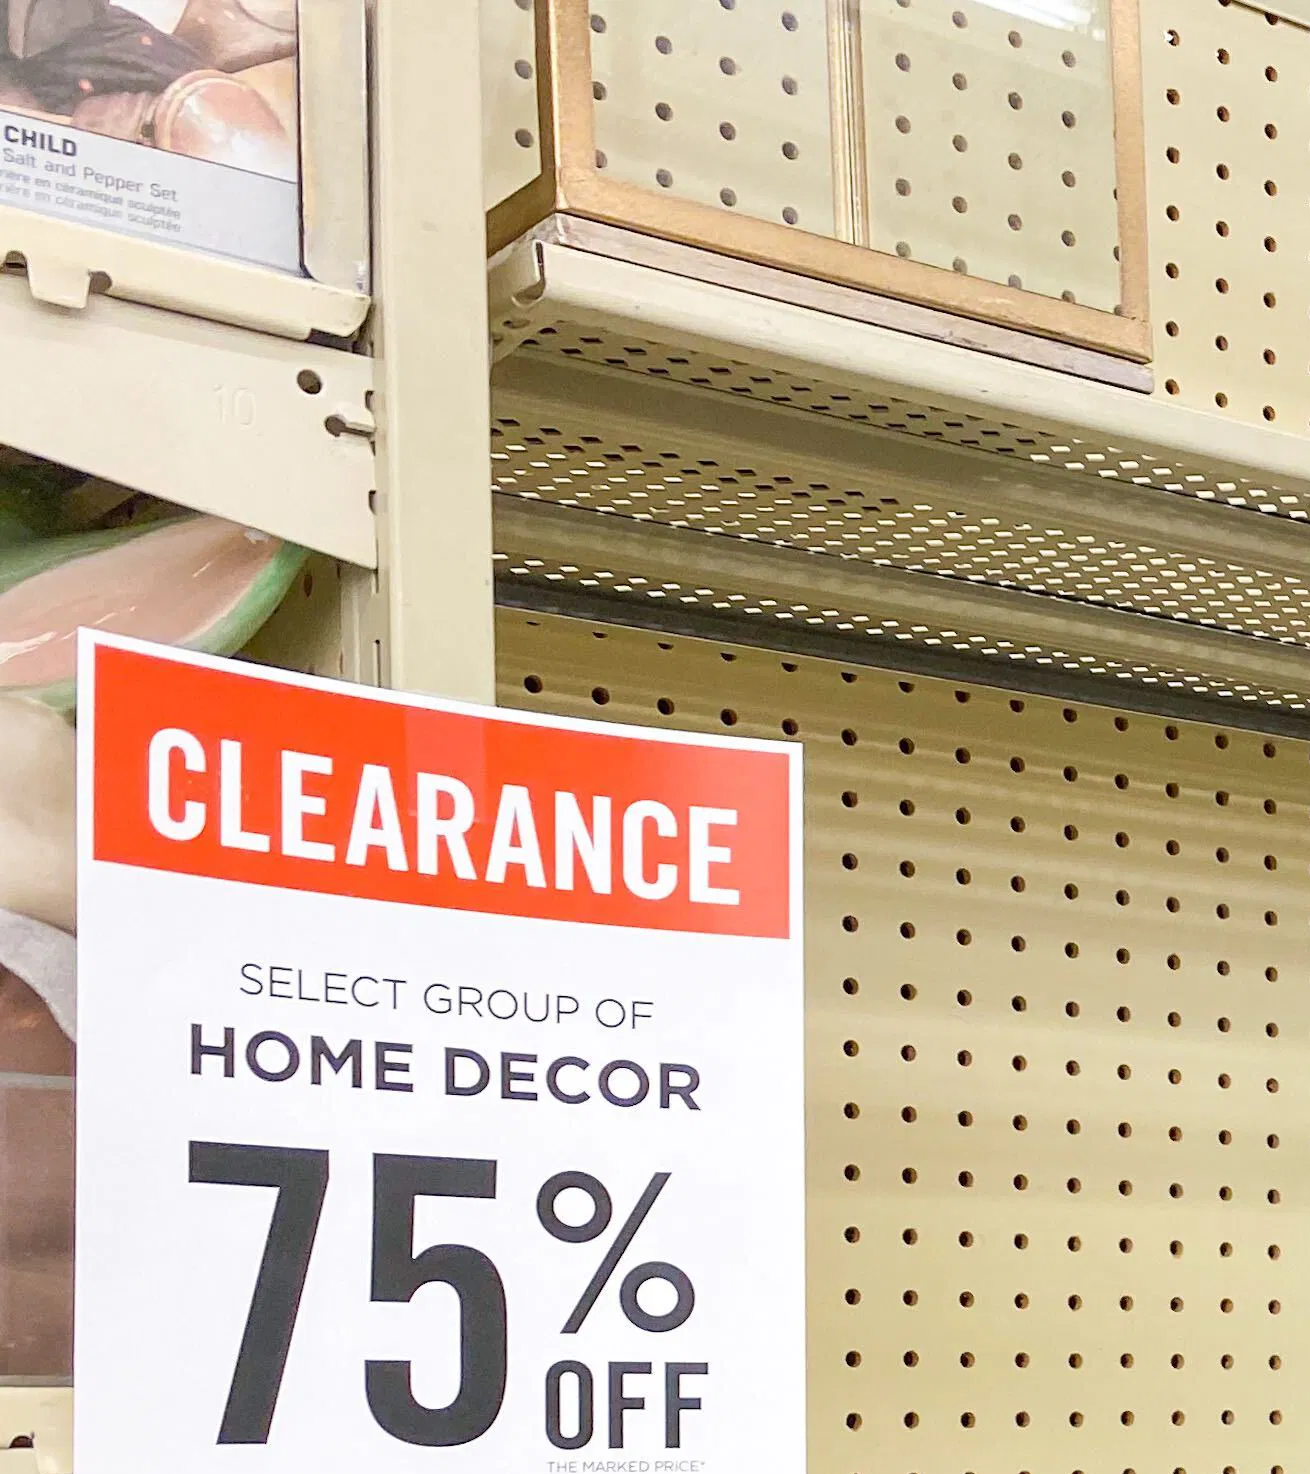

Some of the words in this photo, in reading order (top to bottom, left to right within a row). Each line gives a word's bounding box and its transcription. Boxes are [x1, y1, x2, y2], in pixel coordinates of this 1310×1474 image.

[3, 147, 36, 169] Salt
[44, 159, 77, 177] and
[83, 166, 144, 193] Pepper
[150, 183, 178, 202] Set
[4, 125, 77, 157] CHILD
[148, 727, 741, 906] CLEARANCE
[240, 963, 407, 1010] SELECT
[424, 982, 579, 1024] GROUP
[595, 998, 654, 1030] OF
[190, 1022, 414, 1094] HOME
[445, 1046, 702, 1111] DECOR
[545, 1359, 710, 1450] OFF
[547, 1461, 579, 1474] THE
[583, 1460, 651, 1474] MARKED
